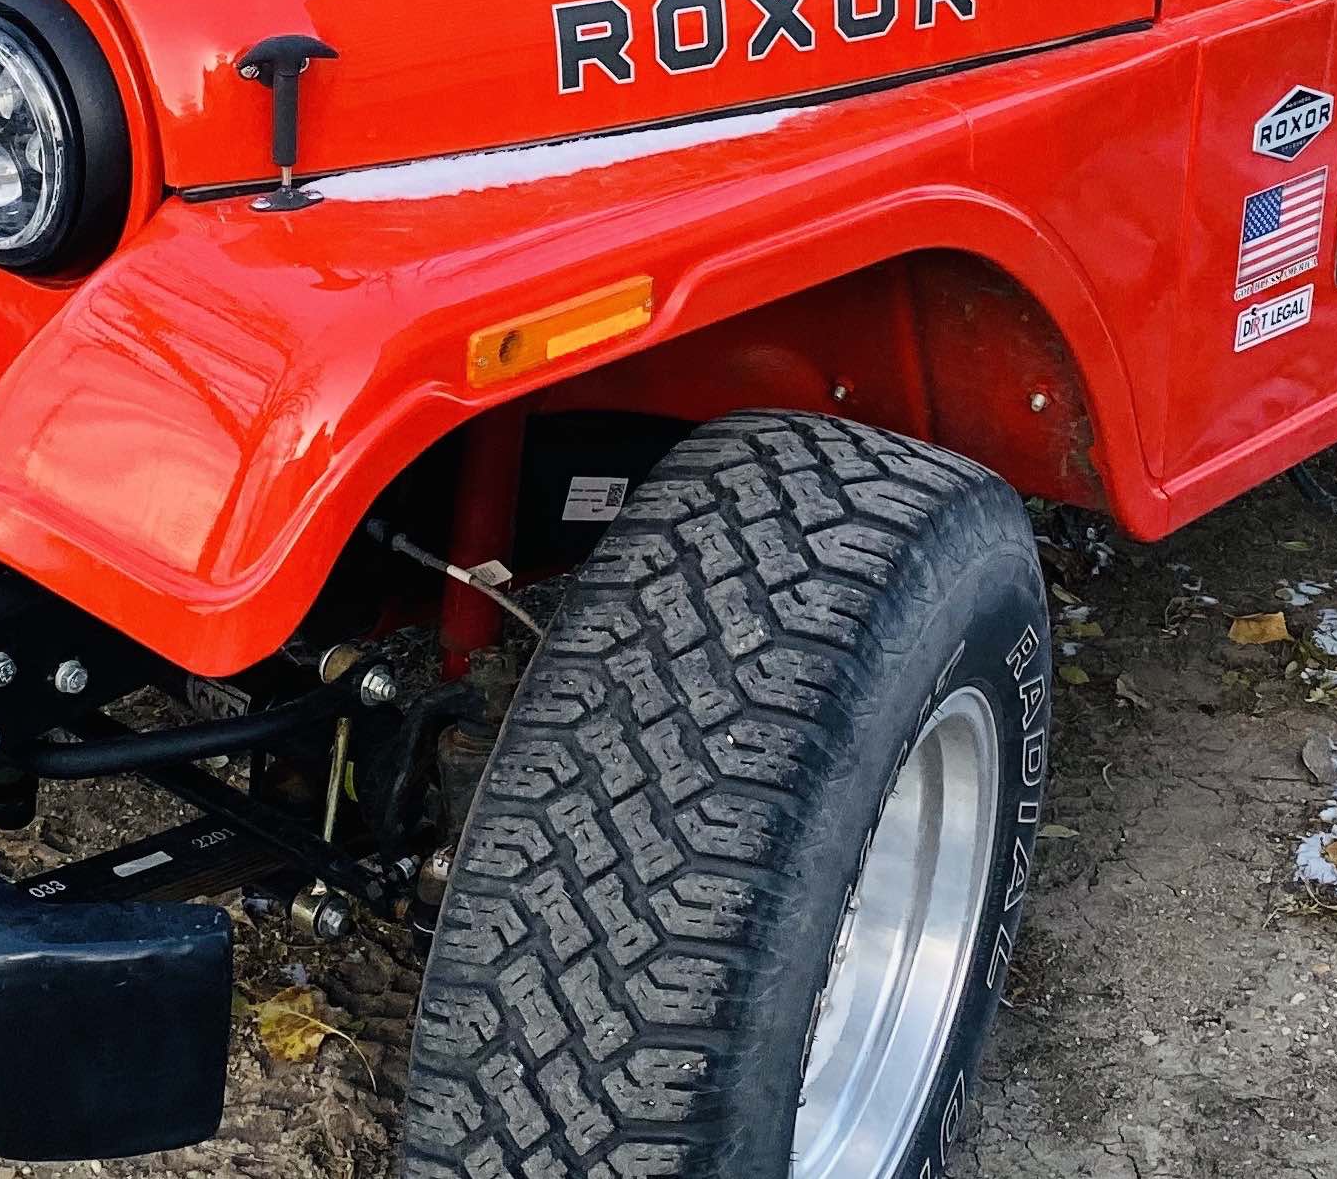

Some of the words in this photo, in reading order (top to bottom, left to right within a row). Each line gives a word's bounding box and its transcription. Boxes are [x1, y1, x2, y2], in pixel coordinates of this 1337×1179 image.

[1260, 103, 1331, 147] ROXOR
[1271, 297, 1304, 326] LEGAL
[986, 624, 1046, 990] RADIAL
[29, 879, 66, 899] 033
[192, 828, 237, 849] 2201
